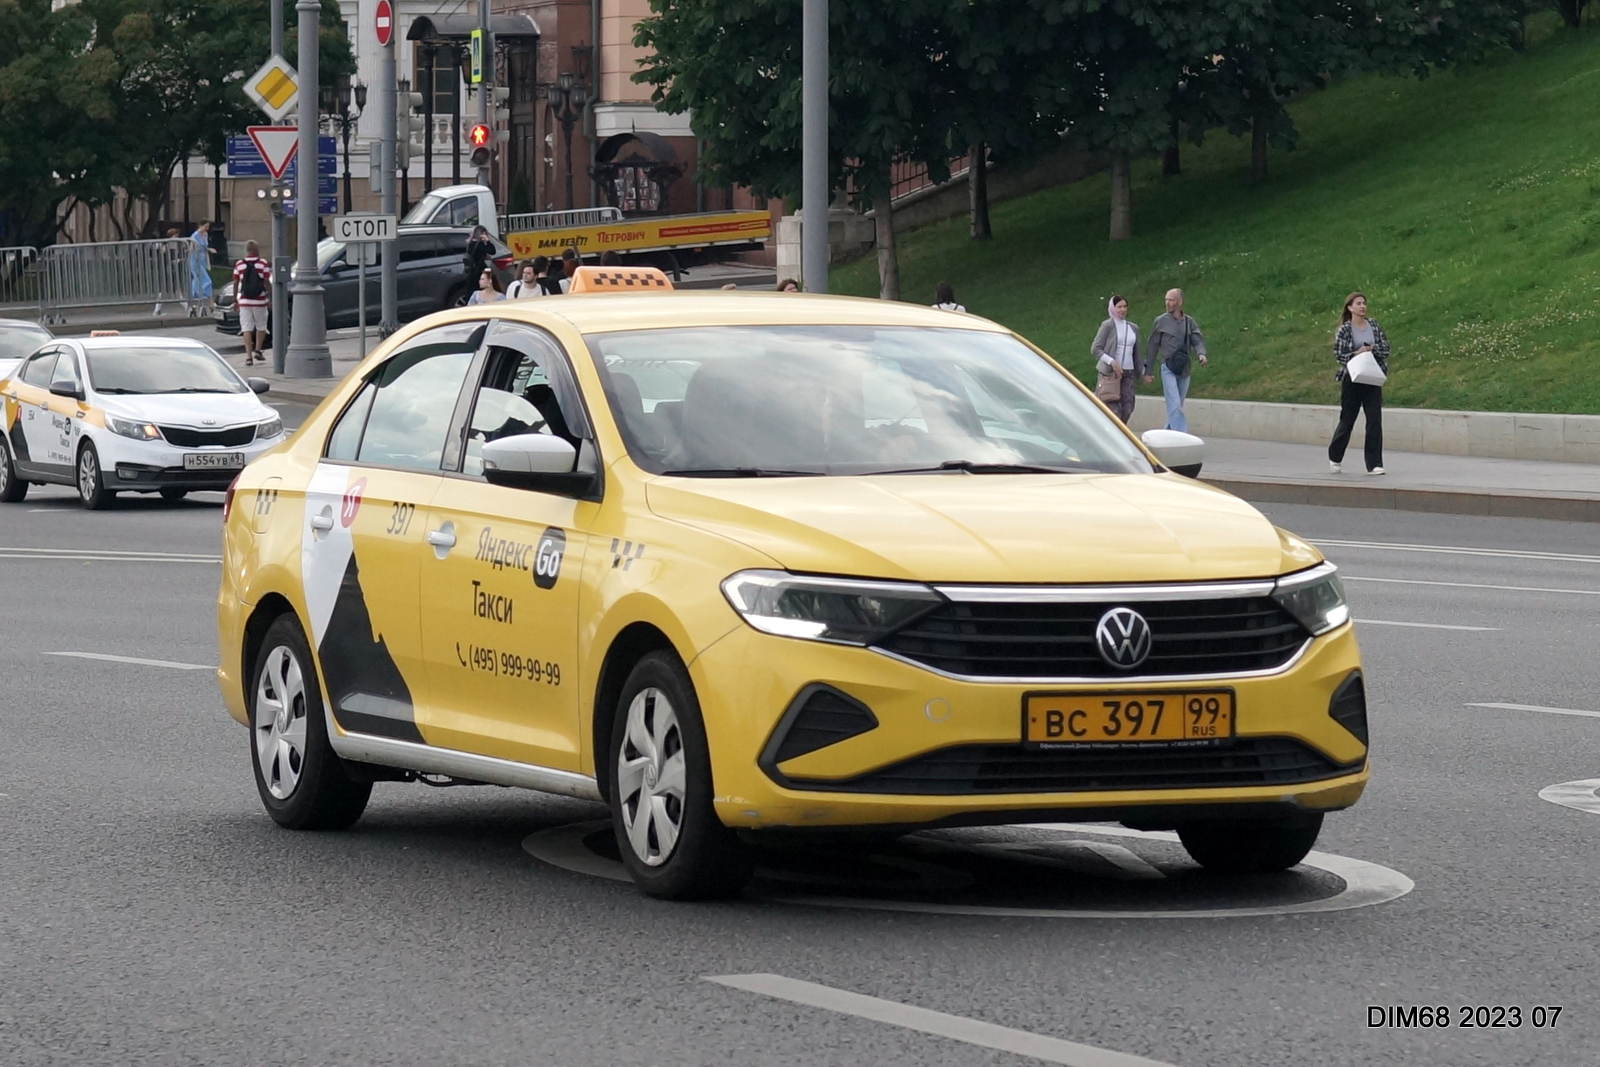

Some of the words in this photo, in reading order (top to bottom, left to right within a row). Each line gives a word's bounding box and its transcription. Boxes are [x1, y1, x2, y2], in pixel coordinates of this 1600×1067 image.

[342, 219, 387, 237] СТОП
[538, 239, 558, 249] ВАМ
[387, 501, 415, 535] 397
[475, 526, 534, 572] Яндекс
[536, 539, 560, 577] Go
[472, 580, 513, 624] Такси
[469, 644, 498, 676] (495)
[501, 652, 561, 686] 999-99-99
[1046, 709, 1088, 737] ВС
[1102, 700, 1165, 736] 397
[1188, 697, 1220, 725] 99
[1192, 725, 1216, 736] RUS
